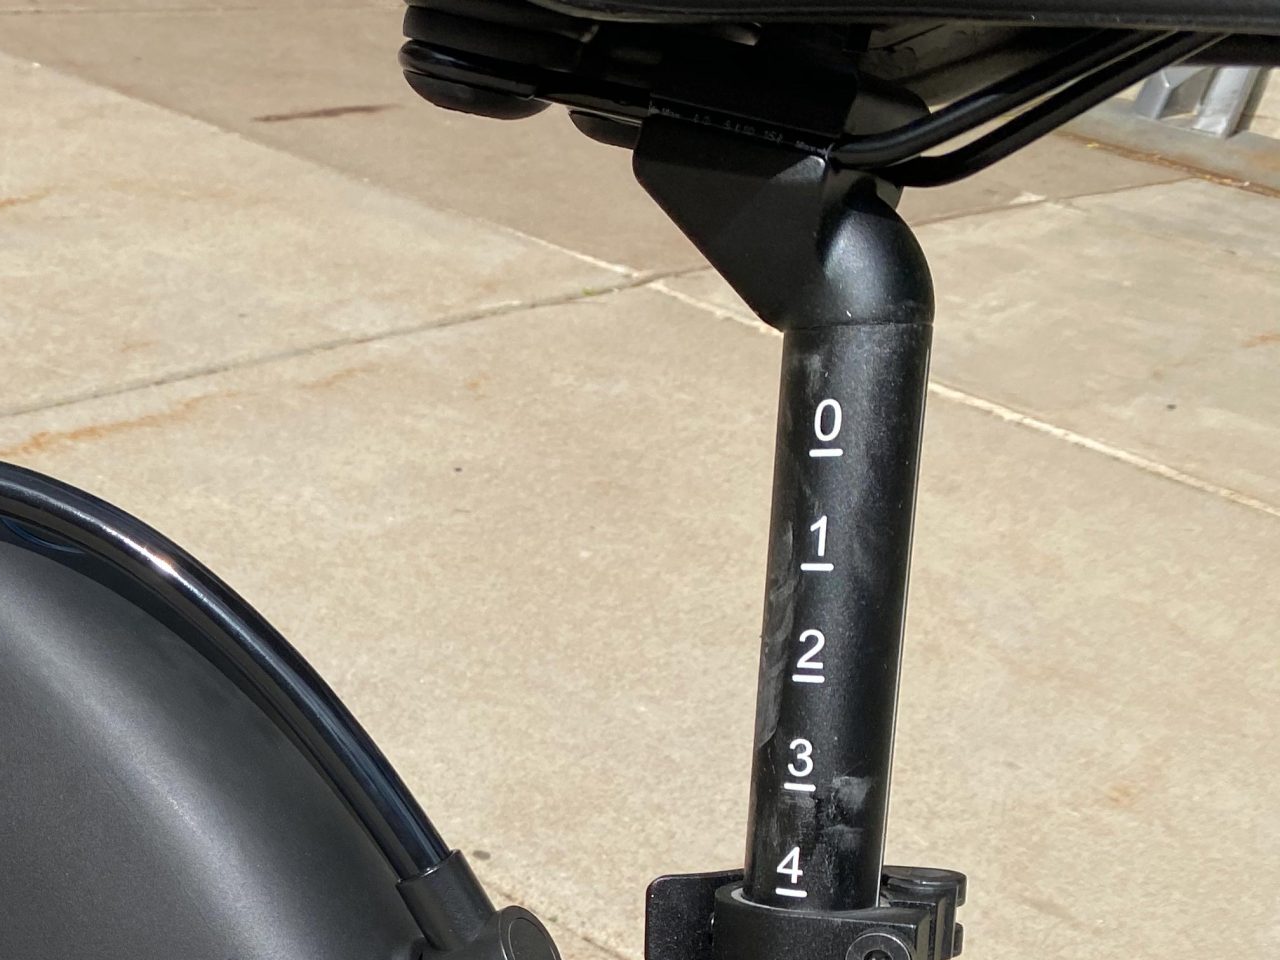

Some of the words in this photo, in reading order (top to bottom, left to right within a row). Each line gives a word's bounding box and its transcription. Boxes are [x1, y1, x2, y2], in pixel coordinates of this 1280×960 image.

[813, 398, 843, 442] 0
[809, 515, 828, 556] 1
[796, 629, 825, 669] 2
[787, 738, 814, 777] 3
[776, 847, 803, 883] 4
